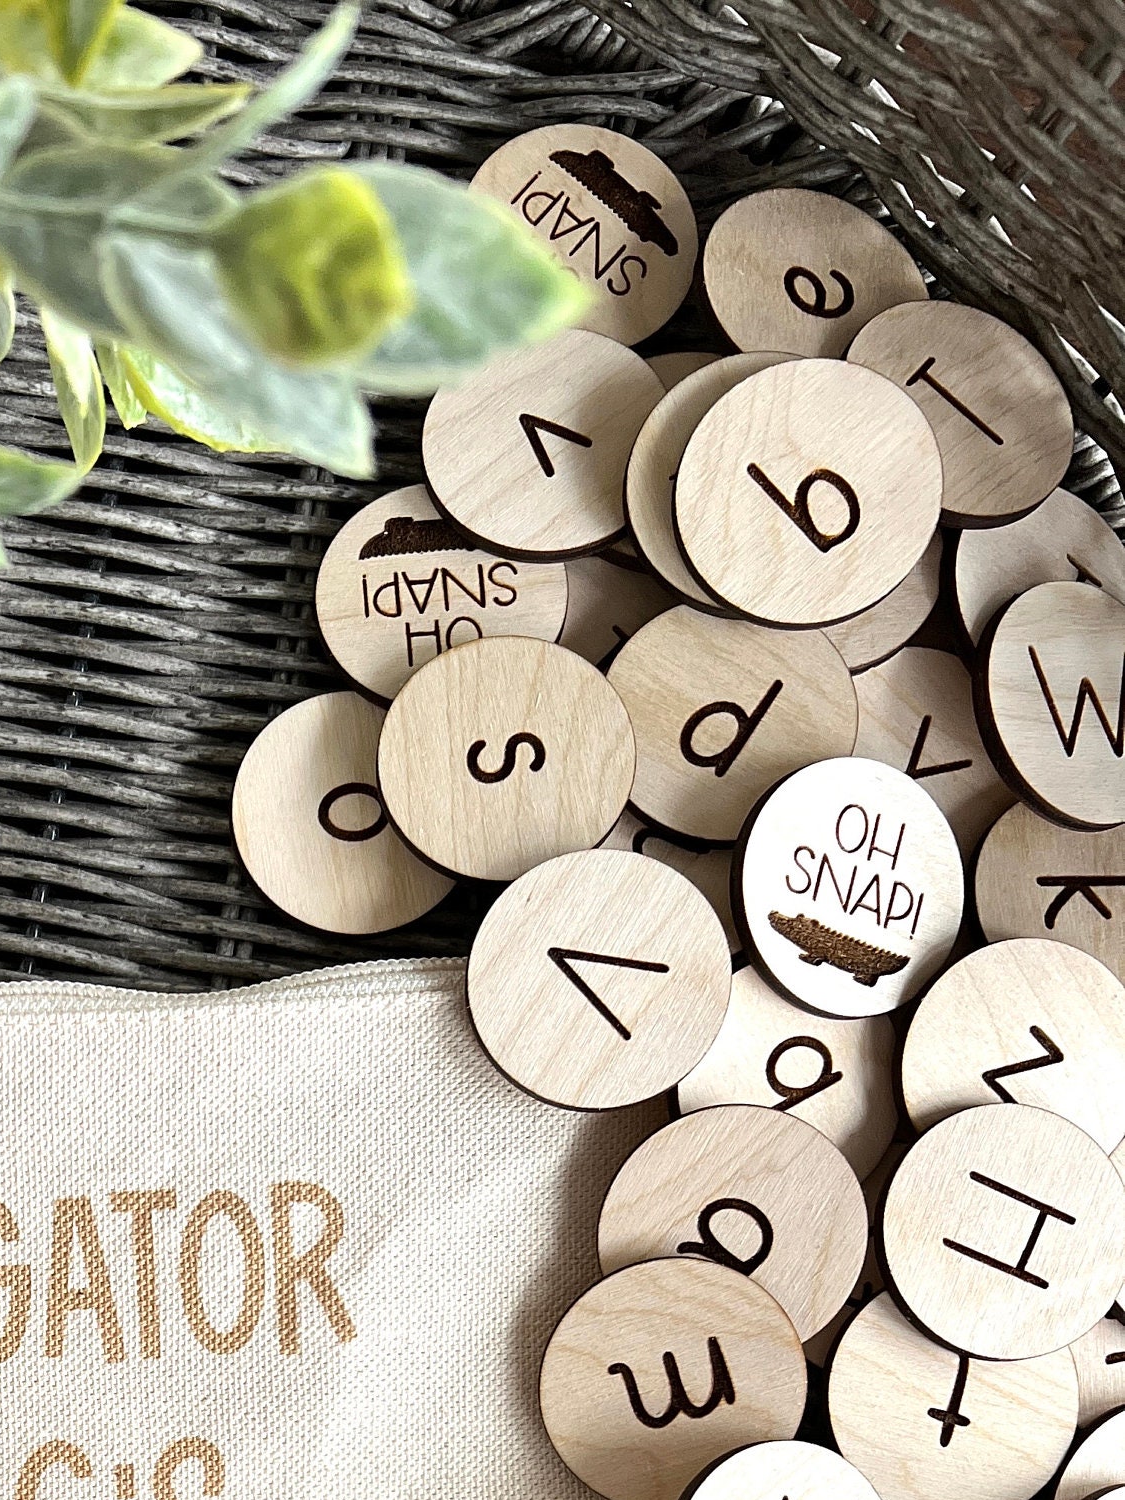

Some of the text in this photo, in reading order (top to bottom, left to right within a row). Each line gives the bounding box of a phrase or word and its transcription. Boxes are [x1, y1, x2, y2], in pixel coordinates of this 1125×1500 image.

[511, 170, 648, 297] SNAP!
[784, 265, 854, 319] e
[362, 561, 518, 618] SNAP!
[836, 804, 905, 870] OH
[785, 845, 925, 940] SNAP!
